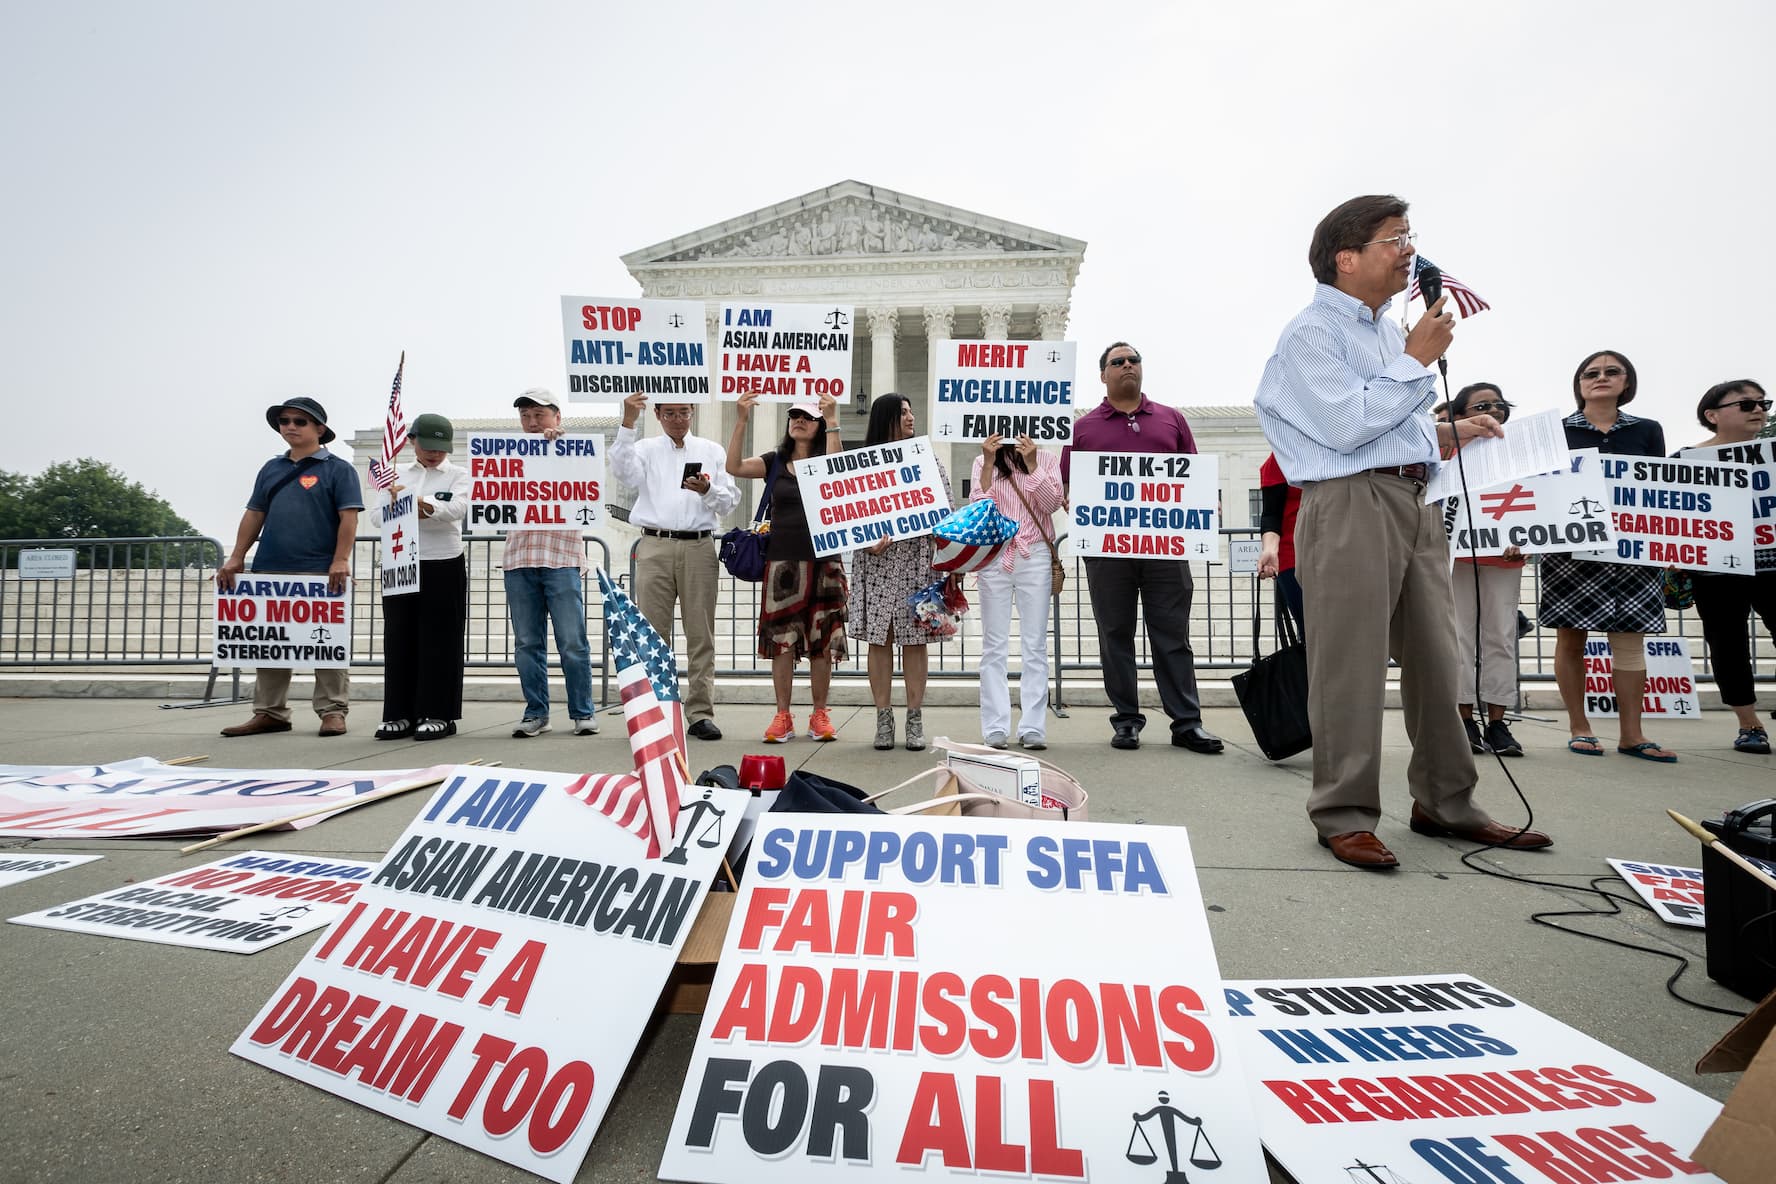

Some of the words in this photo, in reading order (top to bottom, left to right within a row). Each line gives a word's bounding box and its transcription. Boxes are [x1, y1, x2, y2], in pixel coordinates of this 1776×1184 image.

[582, 305, 641, 331] STOP
[725, 308, 732, 326] I
[738, 309, 772, 327] AM
[571, 339, 632, 365] ANTI-
[638, 341, 704, 367] ASIAN
[723, 331, 768, 350] ASIAN
[772, 333, 848, 351] AMERICAN
[723, 354, 729, 371] I
[736, 354, 791, 373] HAVE
[796, 355, 811, 373] A
[958, 343, 1029, 369] MERIT
[569, 374, 709, 394] DISCRIMINATION
[722, 376, 796, 395] DREAM
[805, 377, 844, 397] TOO
[938, 379, 1072, 404] EXCELLENCE
[962, 414, 1071, 440] FAIRNESS
[471, 438, 550, 457] SUPPORT
[555, 439, 595, 457] SFFA
[1717, 443, 1766, 465] FIX
[472, 458, 524, 478] FAIR
[826, 449, 880, 475] JUDGE
[880, 447, 904, 464] by
[1098, 455, 1135, 476] FIX
[1138, 457, 1190, 478] K-12
[1601, 459, 1628, 479] LP
[1634, 461, 1749, 489] STUDENTS
[472, 480, 600, 501] ADMISSIONS
[819, 469, 898, 500] CONTENT
[900, 464, 922, 484] OF
[1105, 482, 1135, 502] DO
[1140, 483, 1185, 503] NOT
[1752, 470, 1770, 491] O
[819, 487, 936, 526] CHARACTERS
[1614, 486, 1636, 507] IN
[1642, 489, 1712, 513] NEEDS
[472, 504, 517, 524] FOR
[524, 504, 566, 524] ALL
[1075, 506, 1214, 530] SCAPEGOAT
[813, 528, 849, 552] NOT
[851, 519, 896, 544] SKIN
[1102, 533, 1185, 556] ASIANS
[1457, 528, 1500, 550] KIN
[1509, 521, 1609, 547] COLOR
[1238, 545, 1259, 553] AREA
[1617, 538, 1644, 560] OF
[1649, 541, 1708, 566] RACE
[383, 567, 396, 589] SKIN
[397, 563, 417, 587] COLOR
[218, 598, 257, 622] NO
[266, 600, 345, 623] MORE
[218, 625, 290, 641] RACIAL
[217, 644, 345, 661] STEREOTYPING
[1646, 642, 1682, 656] SFFA
[1584, 658, 1613, 674] FAI
[424, 776, 466, 823] I
[447, 778, 548, 833] AM
[756, 827, 1008, 887] SUPPORT
[1026, 836, 1169, 895] SFFA
[156, 868, 255, 890] NO
[228, 875, 362, 905] MOR
[371, 835, 485, 902] ASIAN
[472, 850, 701, 946] AMERICAN
[105, 887, 240, 913] RACIAL
[46, 901, 293, 942] STEREOTYPING
[737, 887, 918, 958] FAIR
[315, 902, 370, 961] I
[343, 910, 503, 1000] HAVE
[478, 939, 548, 1017] A
[1254, 981, 1516, 1017] STUDENTS
[710, 962, 1217, 1073] ADMISSIONS
[1258, 1028, 1350, 1064] IN
[1324, 1022, 1518, 1063] NEEDS
[249, 977, 465, 1105] DREAM
[447, 1032, 595, 1155] TOO
[1261, 1064, 1657, 1125] REGARDLESS
[684, 1056, 875, 1162] FOR
[895, 1070, 1085, 1178] ALL
[1409, 1136, 1528, 1184] OF
[1490, 1124, 1713, 1184] RACE
